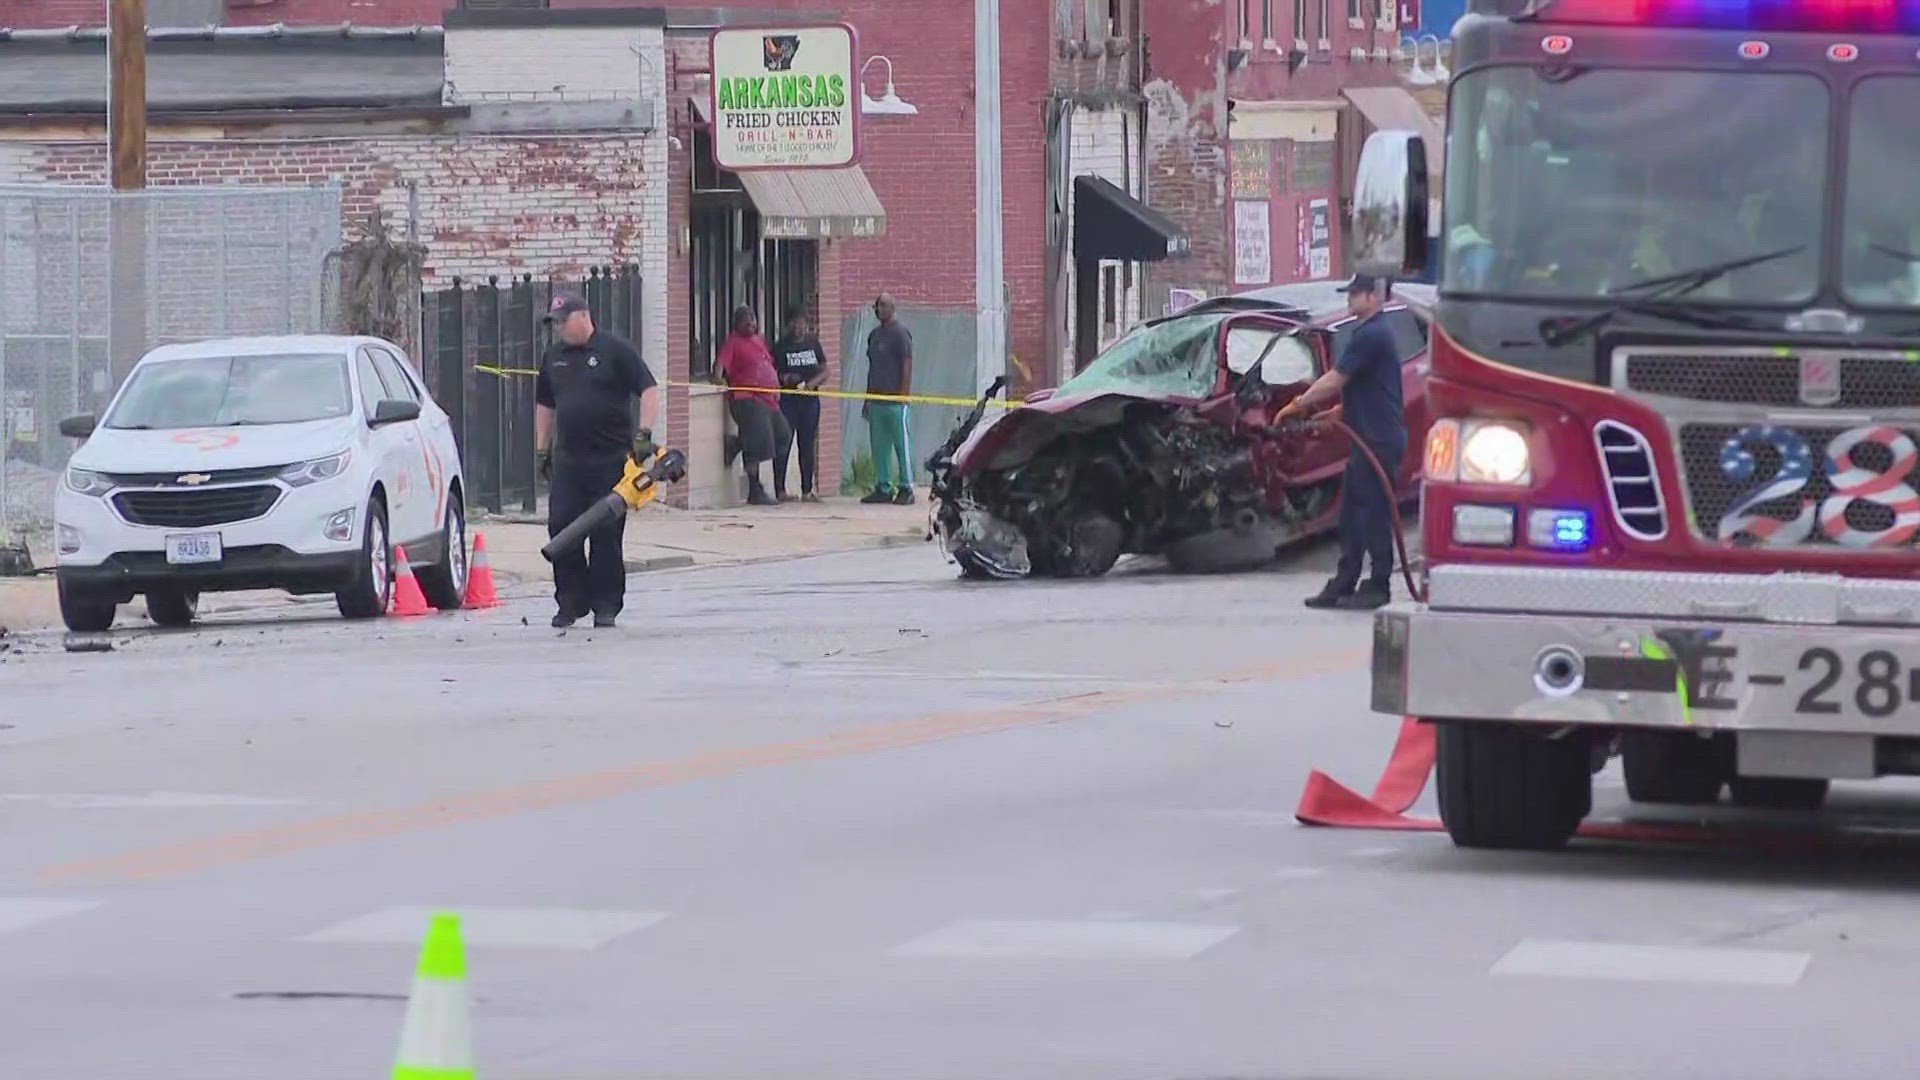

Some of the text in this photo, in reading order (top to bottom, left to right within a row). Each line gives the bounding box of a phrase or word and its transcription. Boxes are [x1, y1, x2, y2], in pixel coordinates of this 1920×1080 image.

[719, 75, 844, 109] ARKANSAS
[726, 111, 841, 128] FRIED CHICKEN
[1717, 423, 1920, 548] 28
